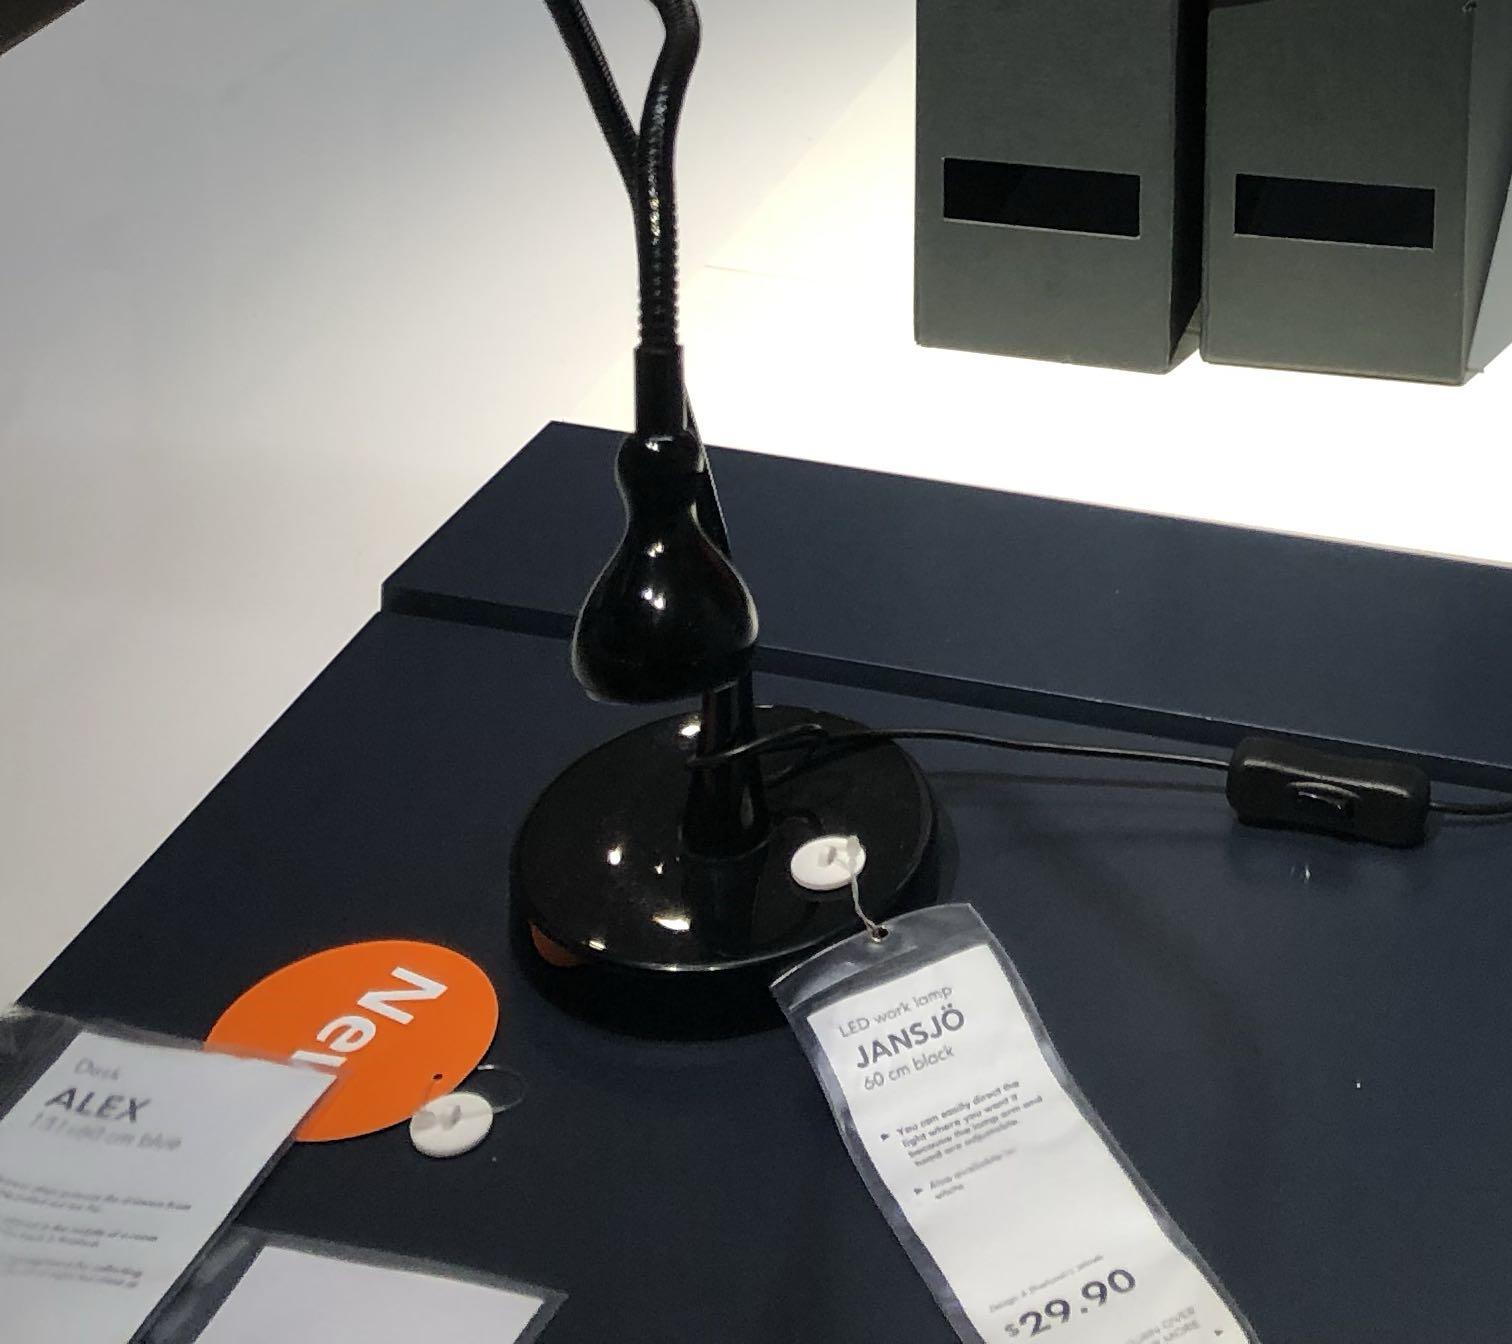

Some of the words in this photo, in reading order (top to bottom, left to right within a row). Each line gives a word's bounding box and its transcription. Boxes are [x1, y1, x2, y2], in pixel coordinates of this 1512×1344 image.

[838, 1014, 870, 1040] LED
[873, 1000, 912, 1029] work
[912, 983, 954, 1015] lamp
[855, 1002, 966, 1070] JANSJÖ
[863, 1070, 885, 1092] 60
[887, 1063, 911, 1083] cm
[912, 1044, 955, 1071] black
[44, 1086, 152, 1124] ALEX
[1003, 1268, 1137, 1339] $29.90
